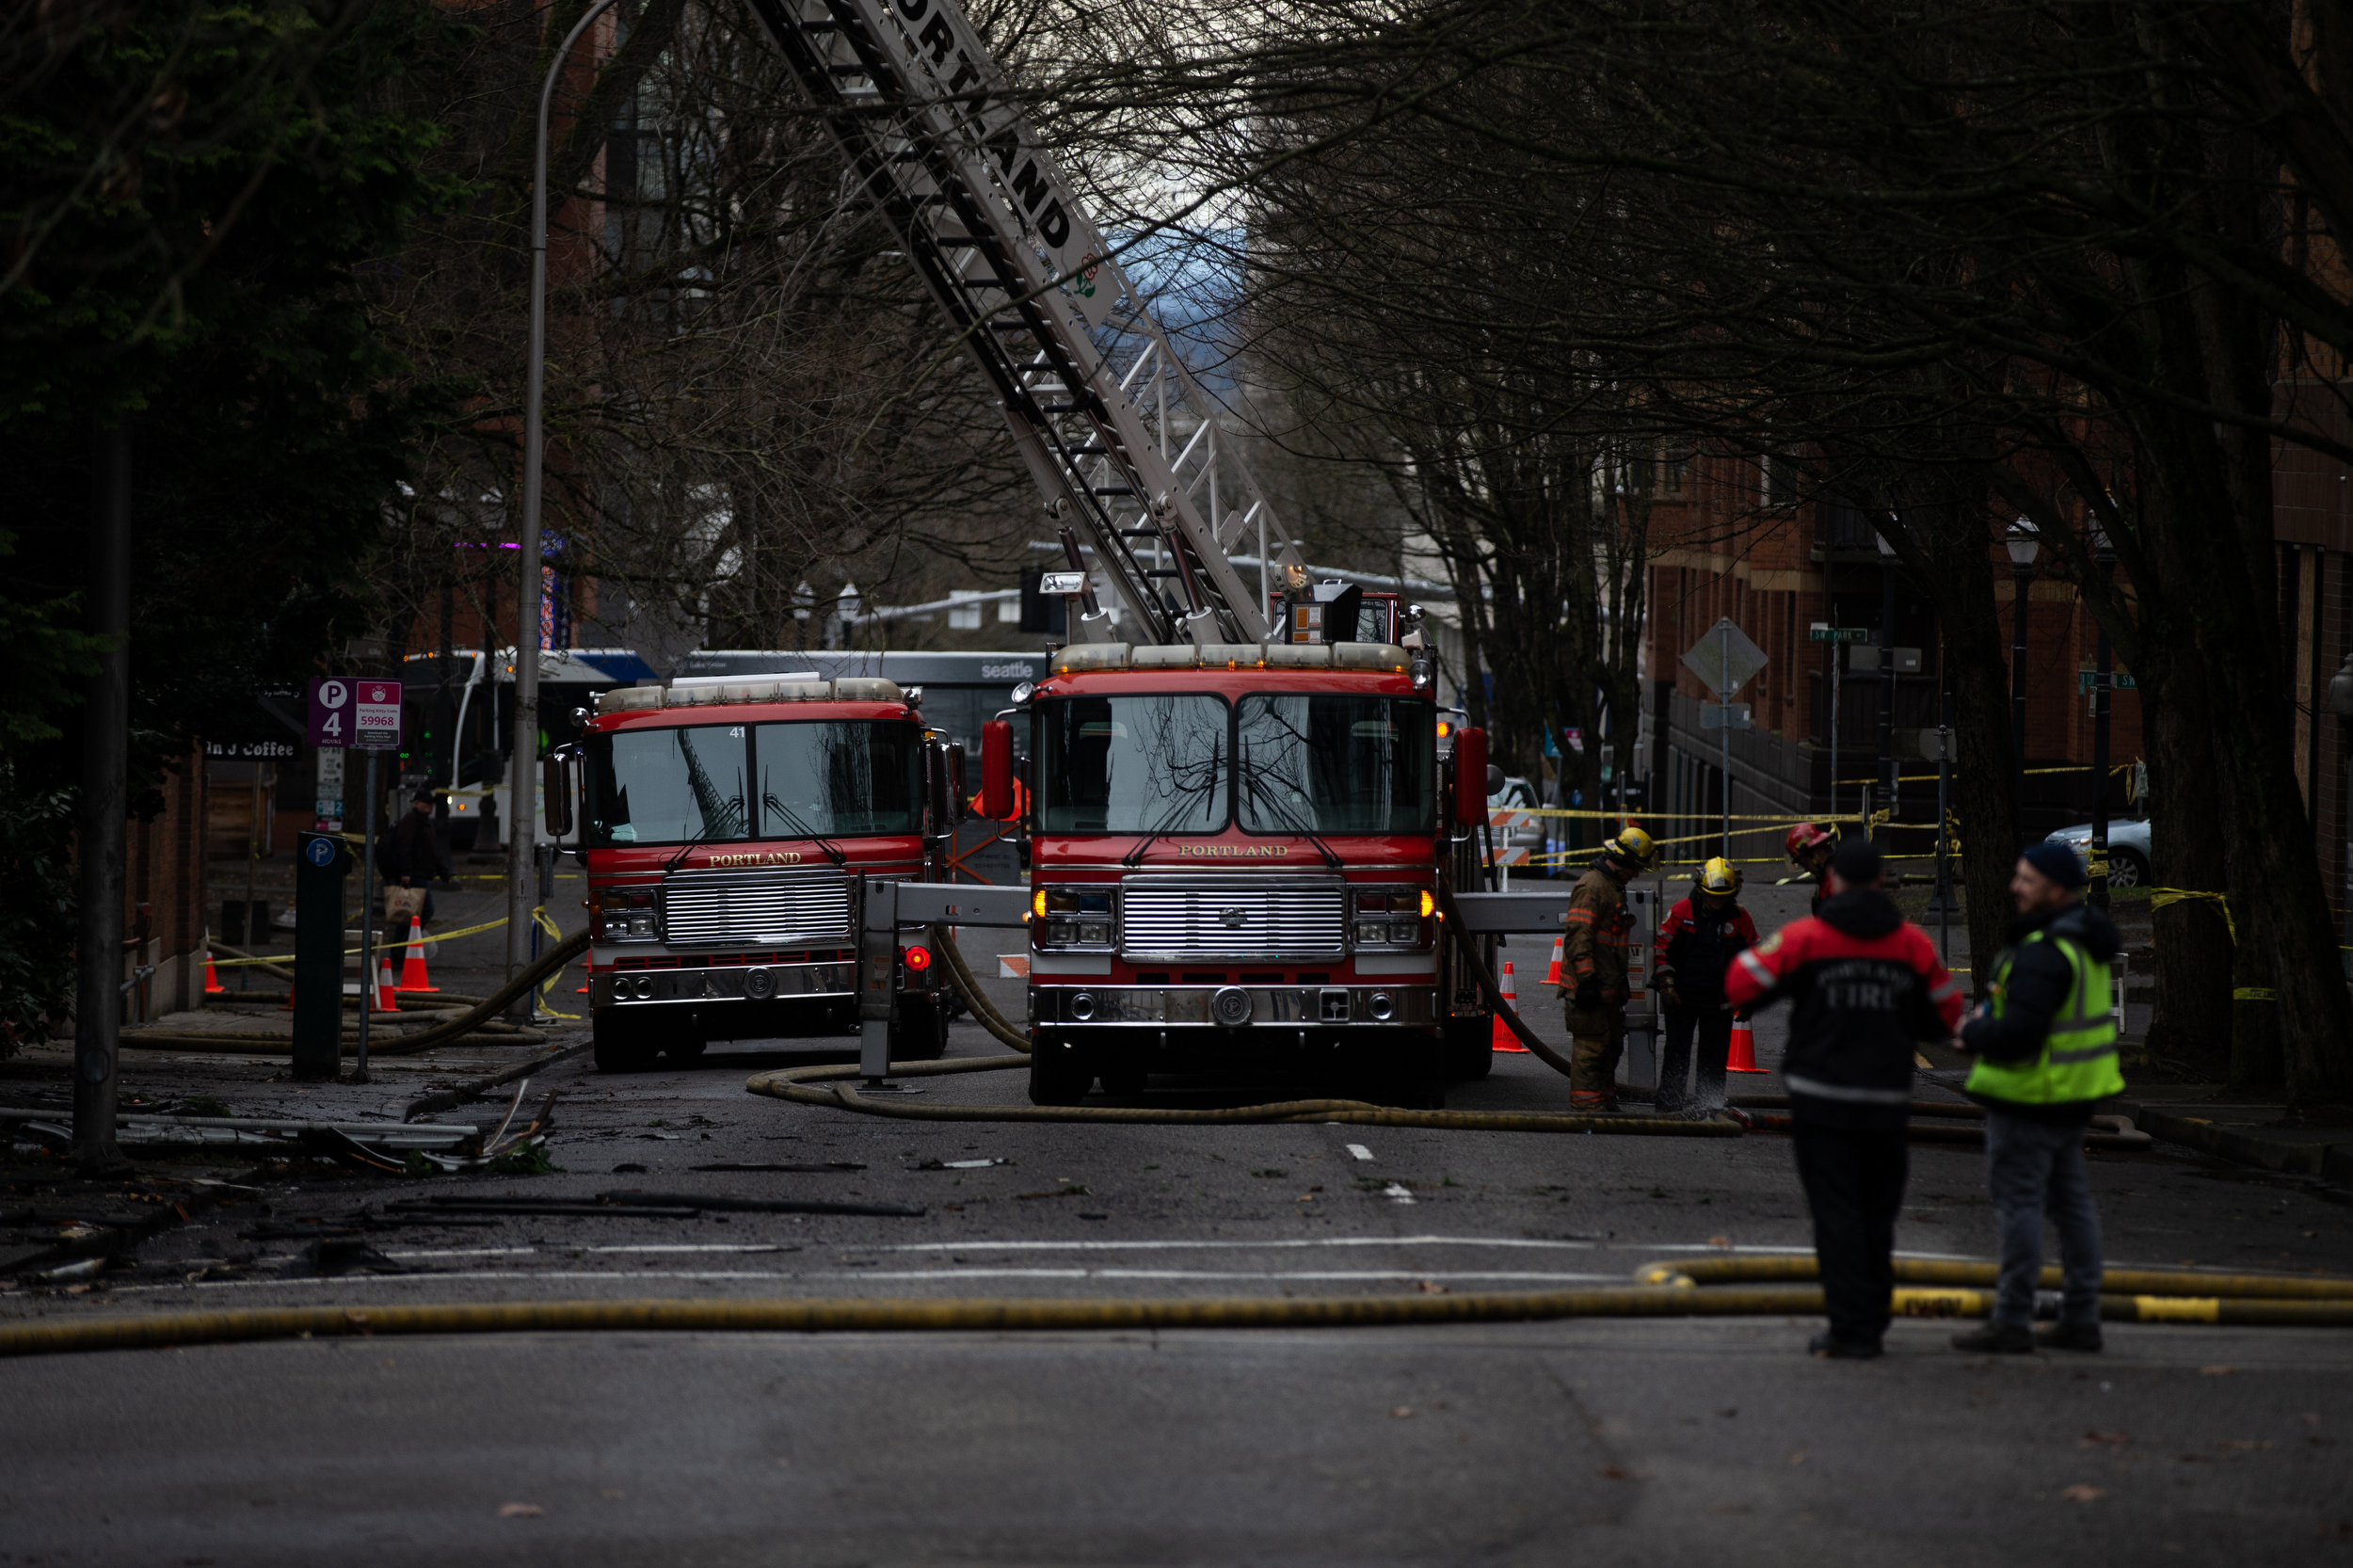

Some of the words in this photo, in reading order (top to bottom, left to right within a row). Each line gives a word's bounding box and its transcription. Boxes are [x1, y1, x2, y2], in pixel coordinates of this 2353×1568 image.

[1815, 631, 1826, 640] SW
[1833, 631, 1852, 640] PARK
[982, 661, 1033, 678] seattle
[328, 685, 341, 704] P
[322, 712, 342, 737] 4
[360, 715, 394, 726] 59968
[729, 727, 745, 738] 41
[243, 741, 294, 757] Coffee
[315, 843, 328, 862] P
[1178, 845, 1289, 857] PORTLAND
[709, 852, 801, 868] PORTLAND
[1827, 981, 1899, 1010] FIRE
